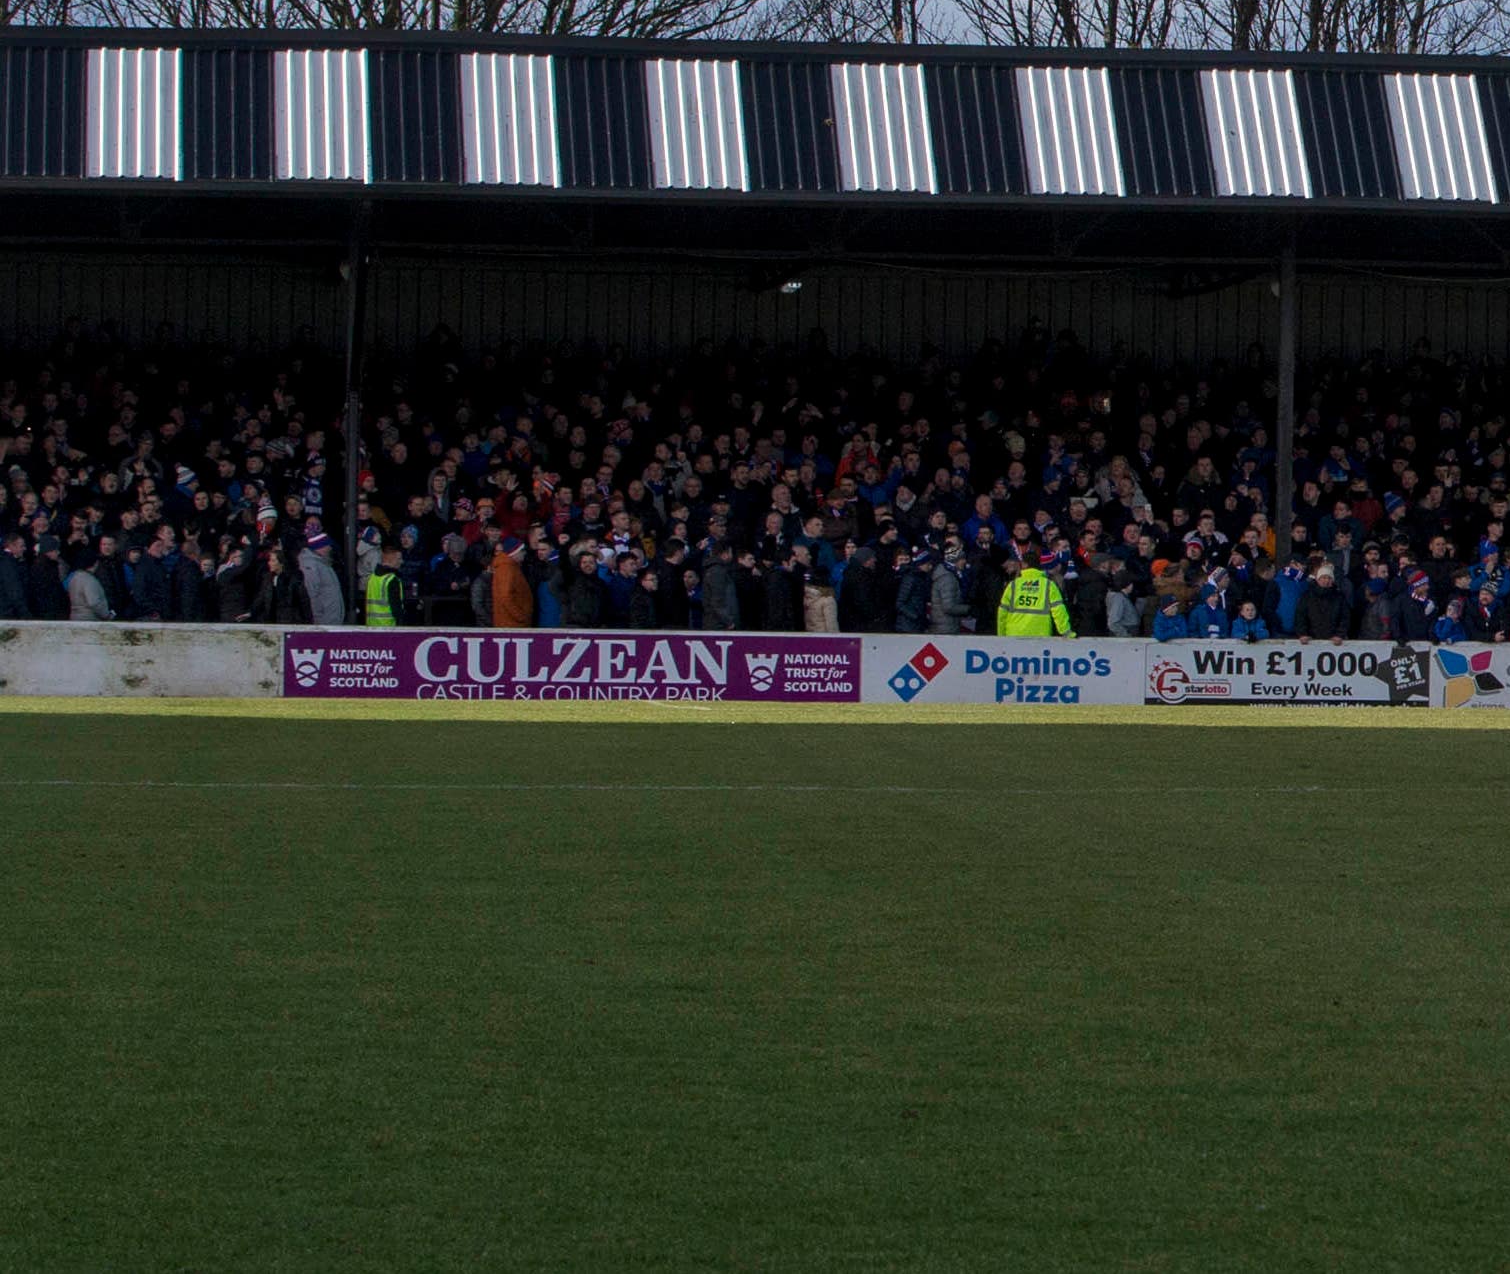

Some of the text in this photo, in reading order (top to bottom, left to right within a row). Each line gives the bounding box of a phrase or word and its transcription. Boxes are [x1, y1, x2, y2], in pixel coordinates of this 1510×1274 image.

[1018, 595, 1038, 607] 557
[329, 649, 397, 661] NATIONAL
[413, 636, 734, 684] CULZEAN
[784, 654, 850, 666] NATIONAL
[1390, 654, 1417, 668] ONLY
[966, 649, 1111, 676] Domino's
[1193, 650, 1378, 681] Win £1,000
[331, 663, 393, 677] TRUST for
[785, 668, 847, 681] TRUST for
[1394, 662, 1422, 685] £1
[329, 677, 399, 688] SCOTLAND
[784, 681, 852, 693] SCOTLAND
[416, 683, 727, 702] CASTLE & COUNTRY PARK
[996, 677, 1080, 703] Pizza
[1251, 683, 1353, 699] Every Week
